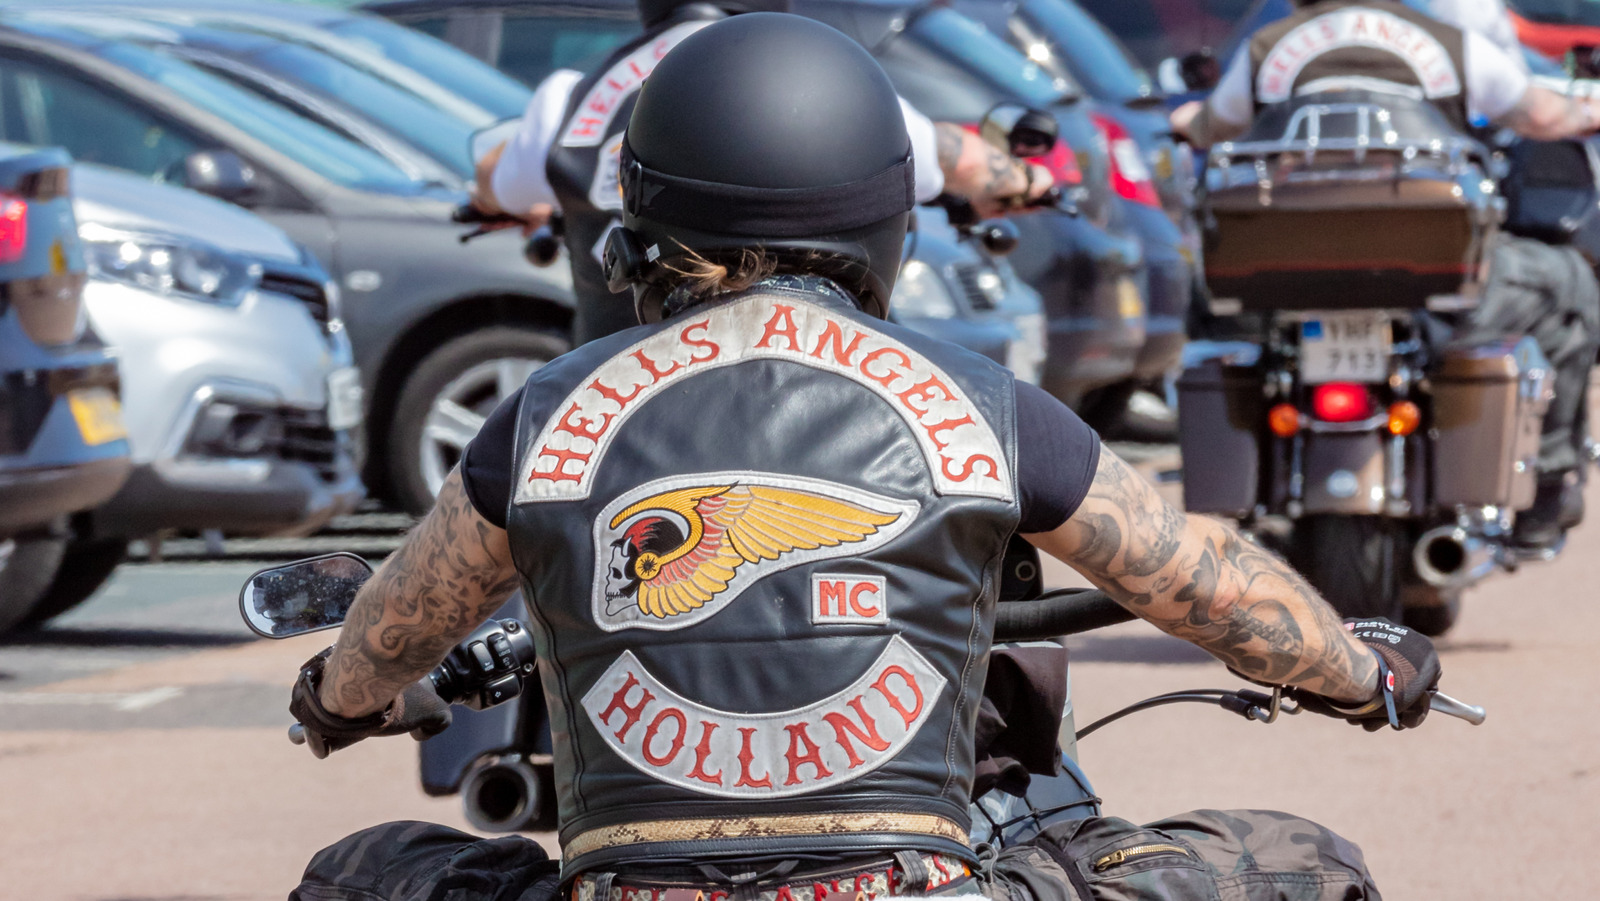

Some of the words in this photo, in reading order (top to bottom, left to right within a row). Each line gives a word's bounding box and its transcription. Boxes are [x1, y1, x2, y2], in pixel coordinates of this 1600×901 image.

[529, 319, 721, 486] HELLS
[753, 304, 1000, 484] ANGELS
[819, 581, 880, 617] MC
[598, 665, 924, 790] HOLLAND
